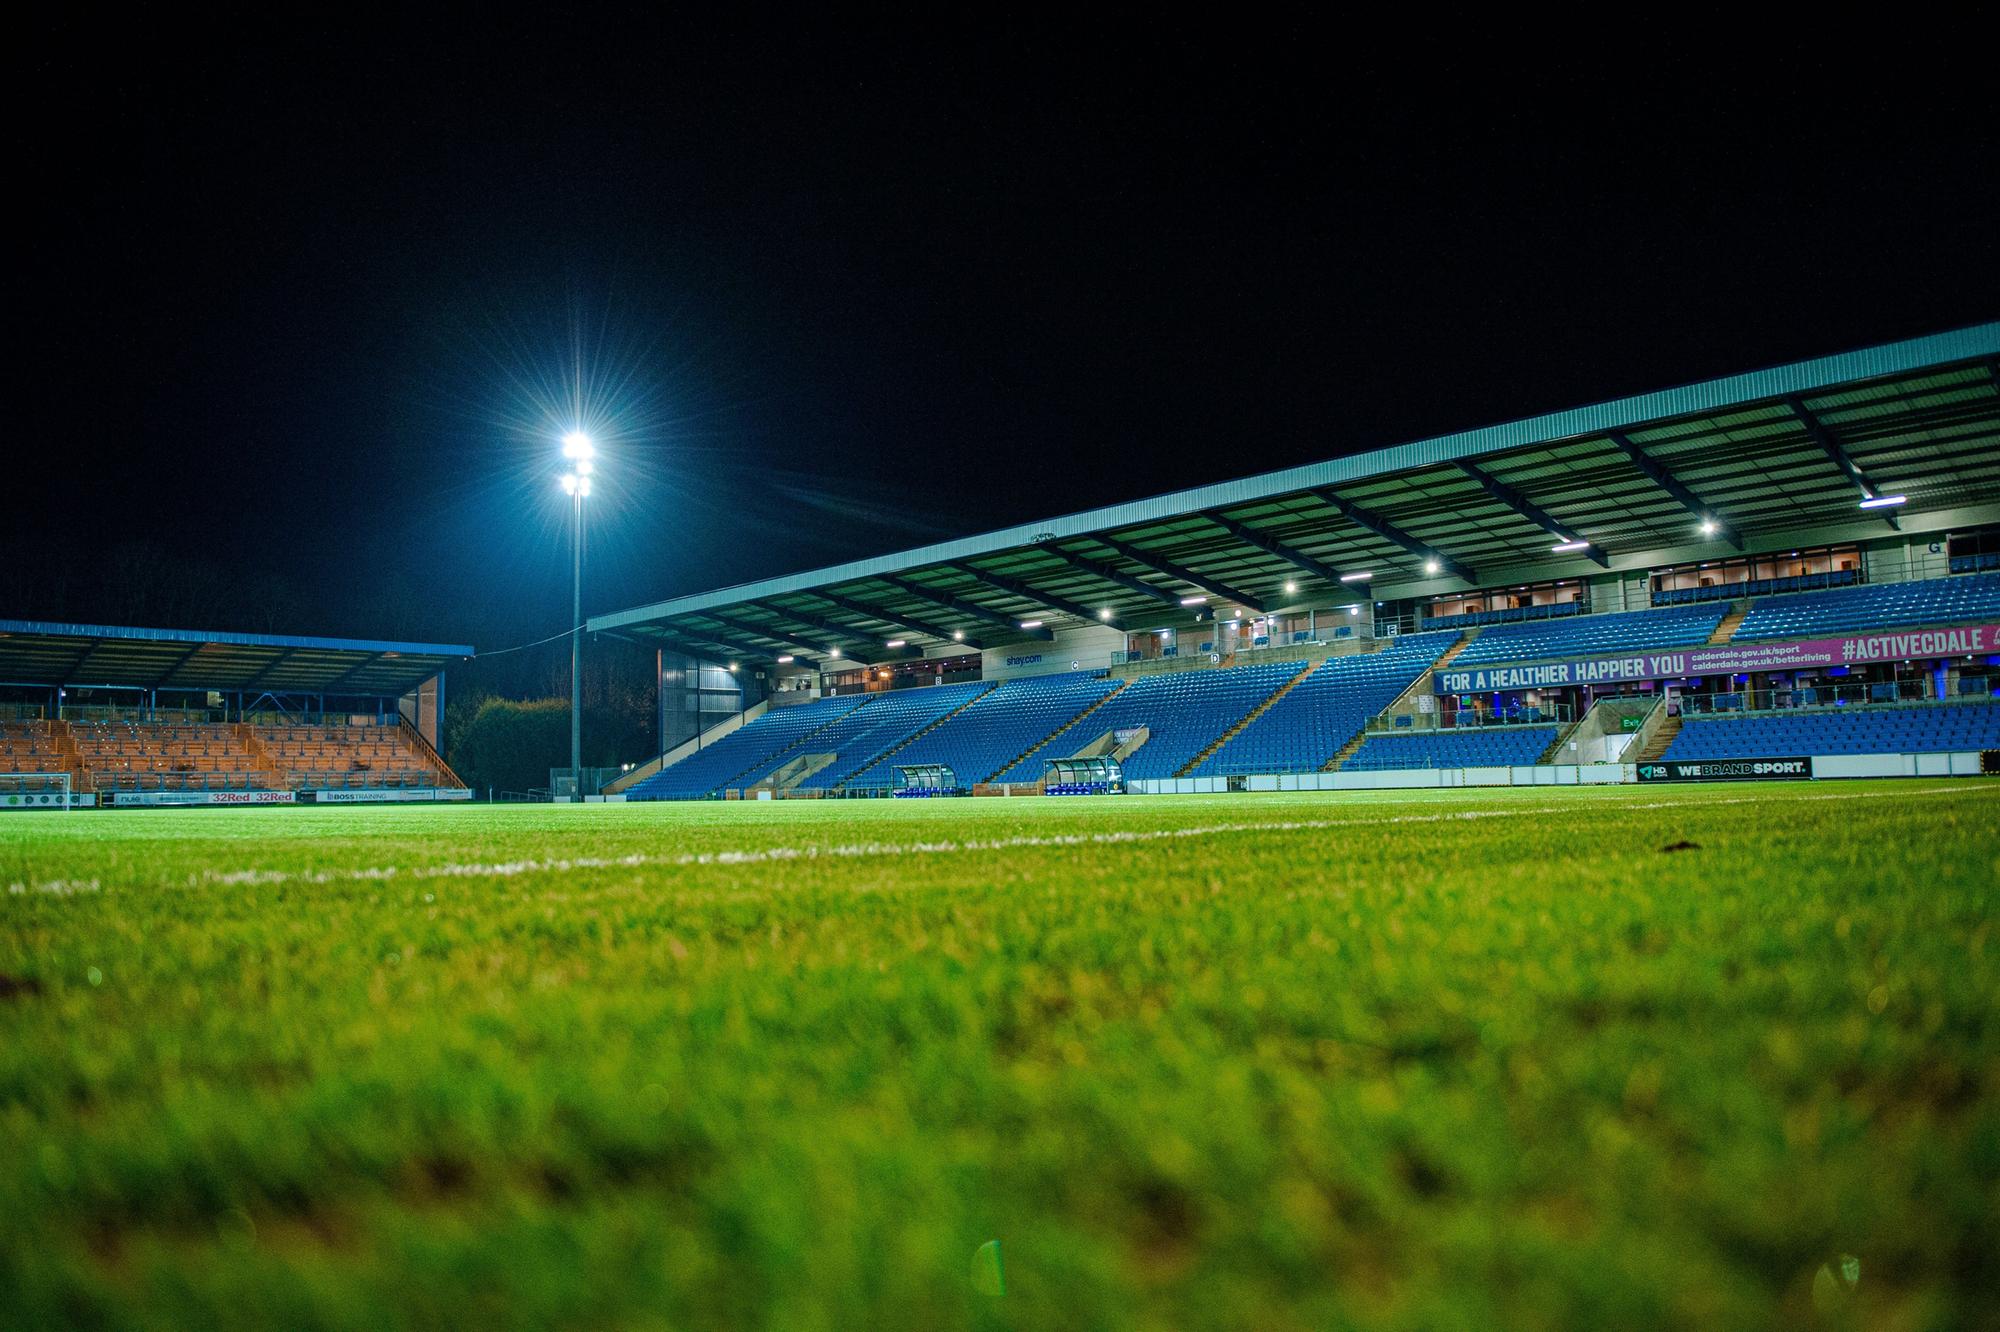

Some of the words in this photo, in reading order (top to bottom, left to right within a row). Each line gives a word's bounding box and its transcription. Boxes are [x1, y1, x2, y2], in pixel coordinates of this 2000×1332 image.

[1929, 541, 1941, 553] G
[1640, 577, 1647, 589] F
[1842, 629, 1984, 660] #ACTIVECDALE
[1691, 645, 1800, 662] calderdale.gov.uk/sport
[1006, 655, 1042, 667] shay.com
[1072, 661, 1078, 669] C
[1692, 653, 1831, 671] calderdale.gov.uk/betterliving
[1443, 673, 1470, 691] FOR
[1475, 671, 1486, 689] A
[1490, 665, 1569, 688] HEALTHIER
[1575, 658, 1645, 681] HAPPIER
[1650, 655, 1684, 675] YOU
[1623, 719, 1640, 727] Exit
[213, 793, 250, 802] 32Red
[255, 793, 292, 801] 32Red
